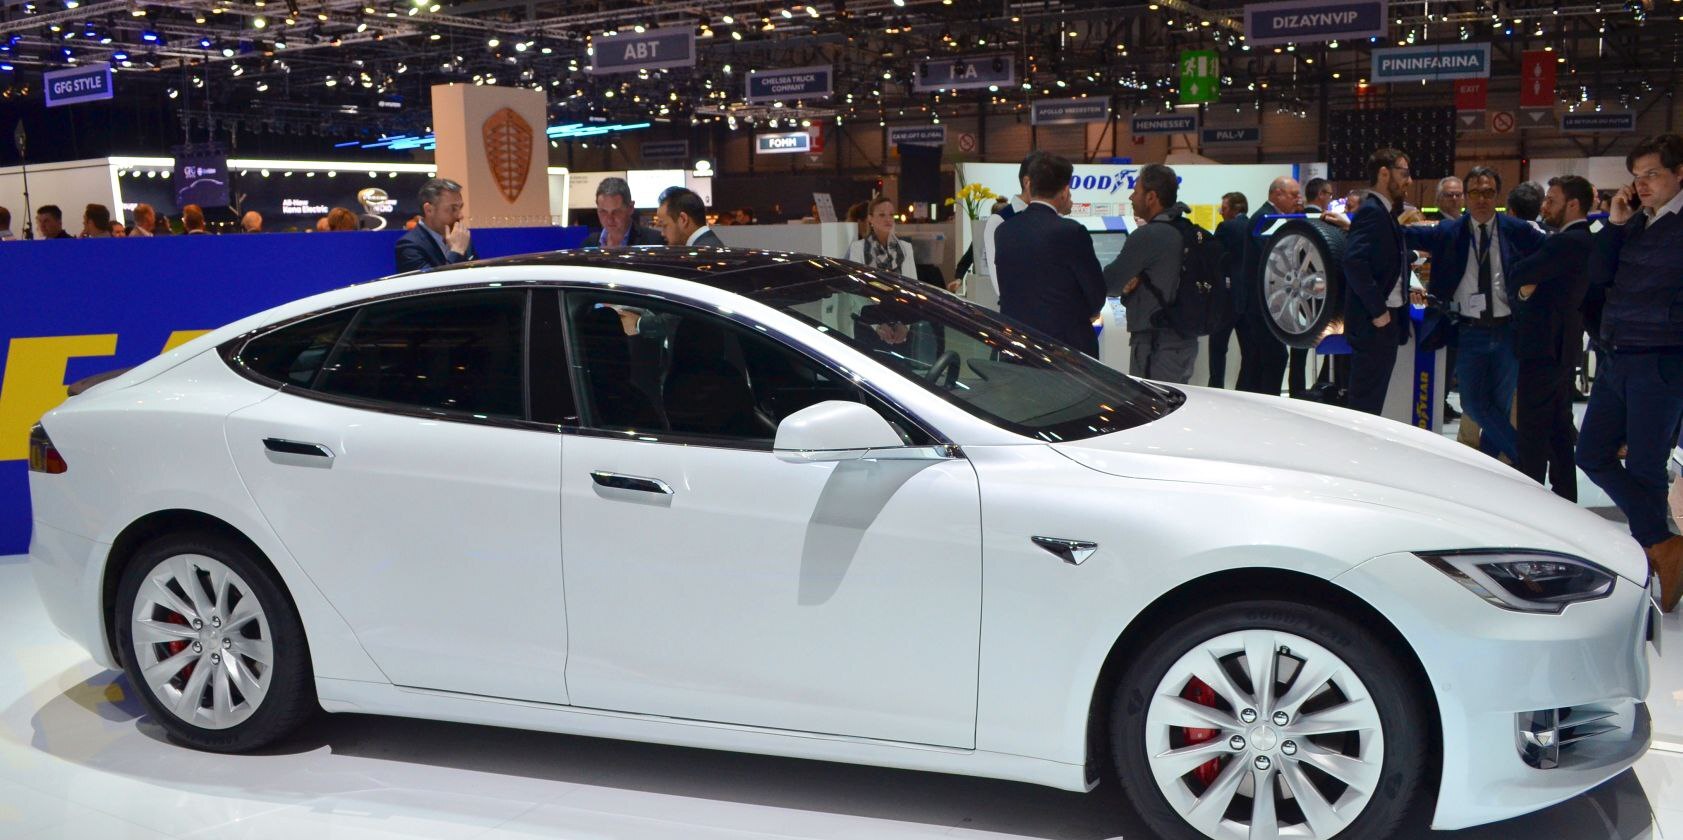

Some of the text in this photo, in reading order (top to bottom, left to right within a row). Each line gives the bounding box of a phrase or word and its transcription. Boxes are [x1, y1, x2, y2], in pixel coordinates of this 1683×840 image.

[1272, 11, 1358, 29] DIZAYNVIP
[624, 41, 659, 60] ABT
[1382, 55, 1479, 71] PININFARINA
[54, 76, 102, 94] GFG STYLE
[761, 74, 816, 85] CHELSEA TRUCK
[771, 83, 805, 92] COMPANY
[1460, 85, 1480, 93] EXIT
[1136, 120, 1191, 129] HENNESSEY
[1216, 130, 1245, 139] PAL-V
[769, 137, 797, 148] FOMM
[302, 205, 329, 214] Electric
